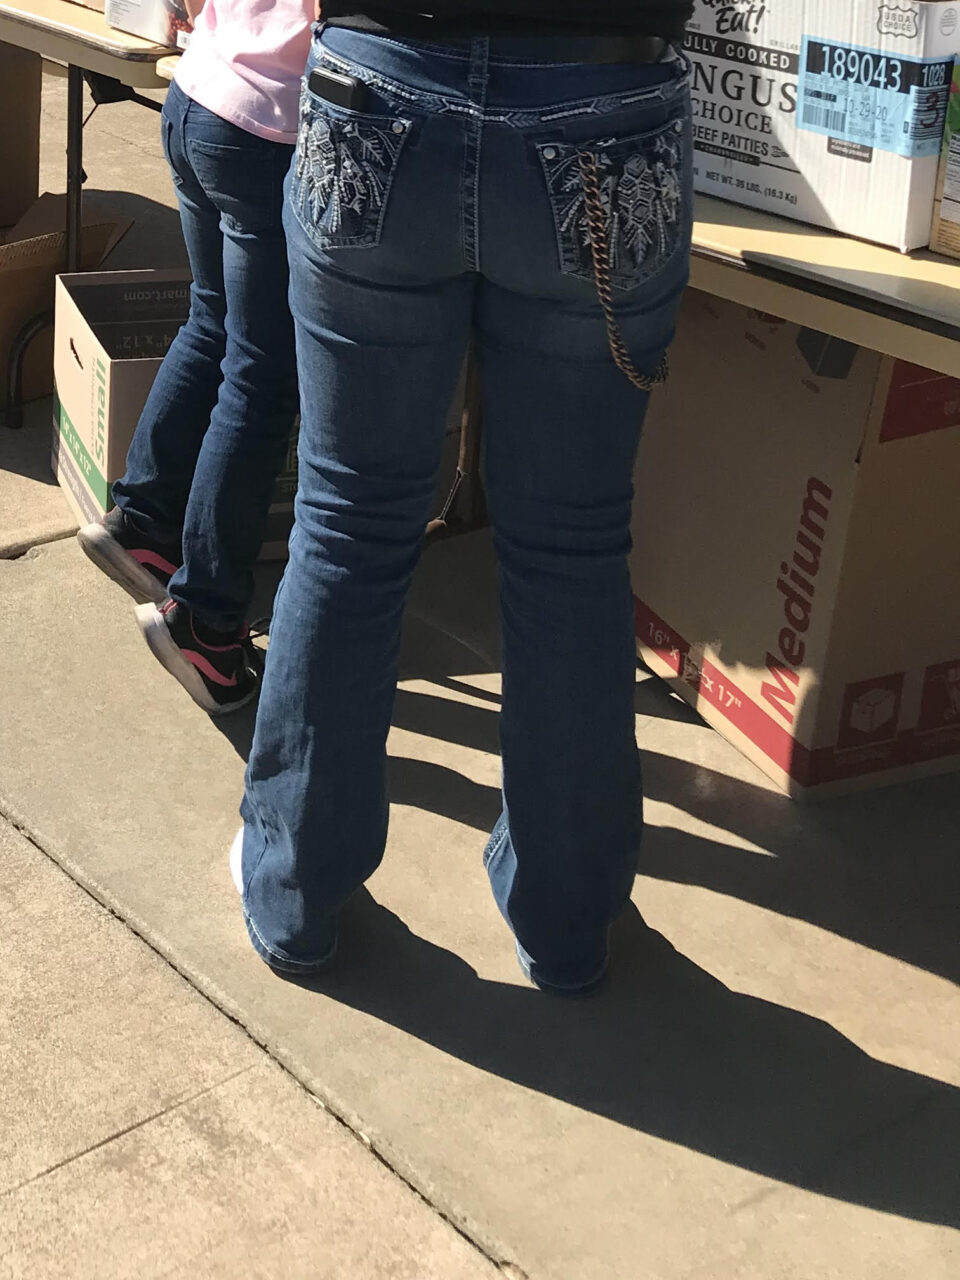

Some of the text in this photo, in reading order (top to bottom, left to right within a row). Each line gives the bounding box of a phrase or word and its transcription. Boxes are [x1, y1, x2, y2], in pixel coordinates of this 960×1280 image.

[715, 5, 766, 34] Eat!
[884, 12, 912, 24] USDA
[884, 20, 912, 33] CHOICE
[683, 35, 790, 69] ULLY COOKED
[821, 46, 902, 92] 189043
[922, 64, 946, 88] 1028
[691, 61, 797, 113] NGUS
[844, 97, 888, 121] 10-29-20
[721, 131, 769, 156] PATTIES
[705, 170, 720, 182] NET
[94, 357, 106, 469] Small
[760, 477, 833, 726] Medium
[648, 622, 670, 645] 16"
[718, 684, 743, 709] 17"
